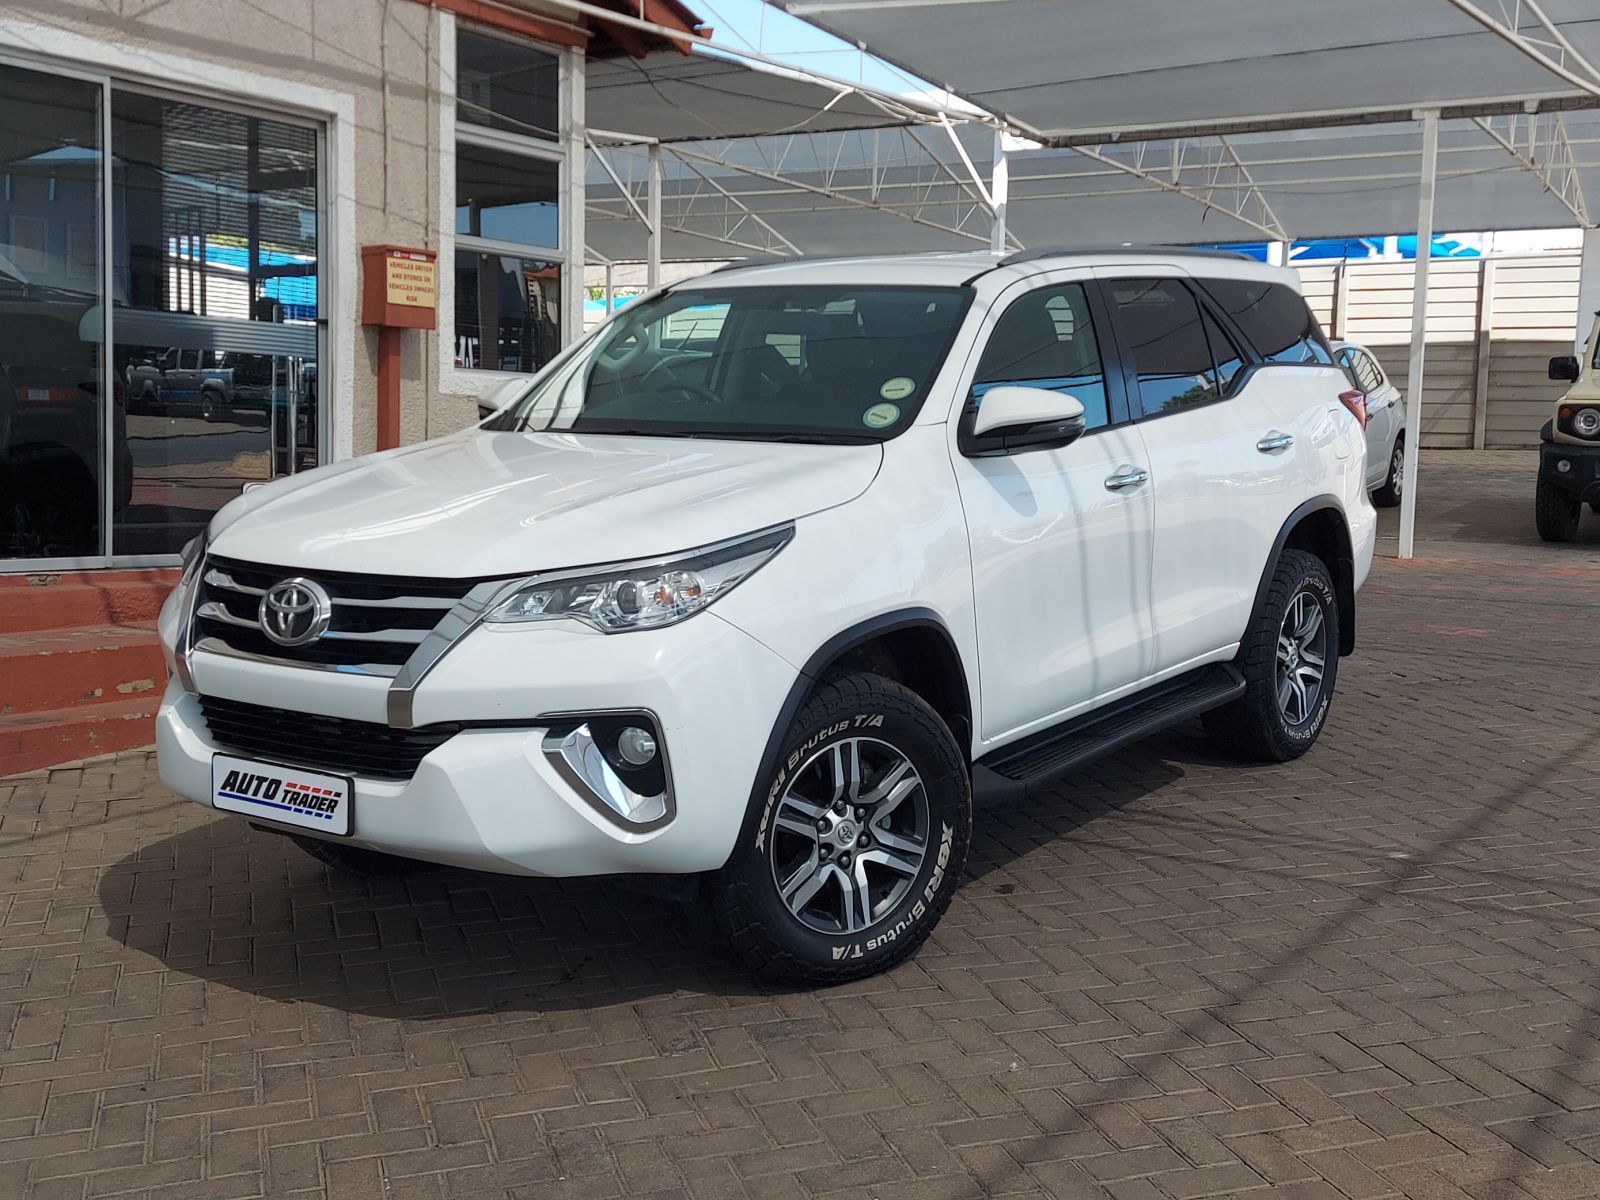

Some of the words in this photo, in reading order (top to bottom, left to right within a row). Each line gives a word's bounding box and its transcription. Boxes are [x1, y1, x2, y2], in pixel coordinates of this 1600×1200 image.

[389, 262, 414, 271] VEHICLES
[392, 272, 403, 280] AND
[404, 273, 423, 282] STORED
[389, 282, 414, 291] VEHICLES
[787, 719, 850, 771] Brutus
[854, 714, 884, 728] T/A
[220, 770, 282, 801] AUTO
[281, 789, 339, 814] TRADER
[924, 819, 954, 903] XBRI
[866, 899, 926, 951] Brutus
[832, 944, 864, 961] T/A
